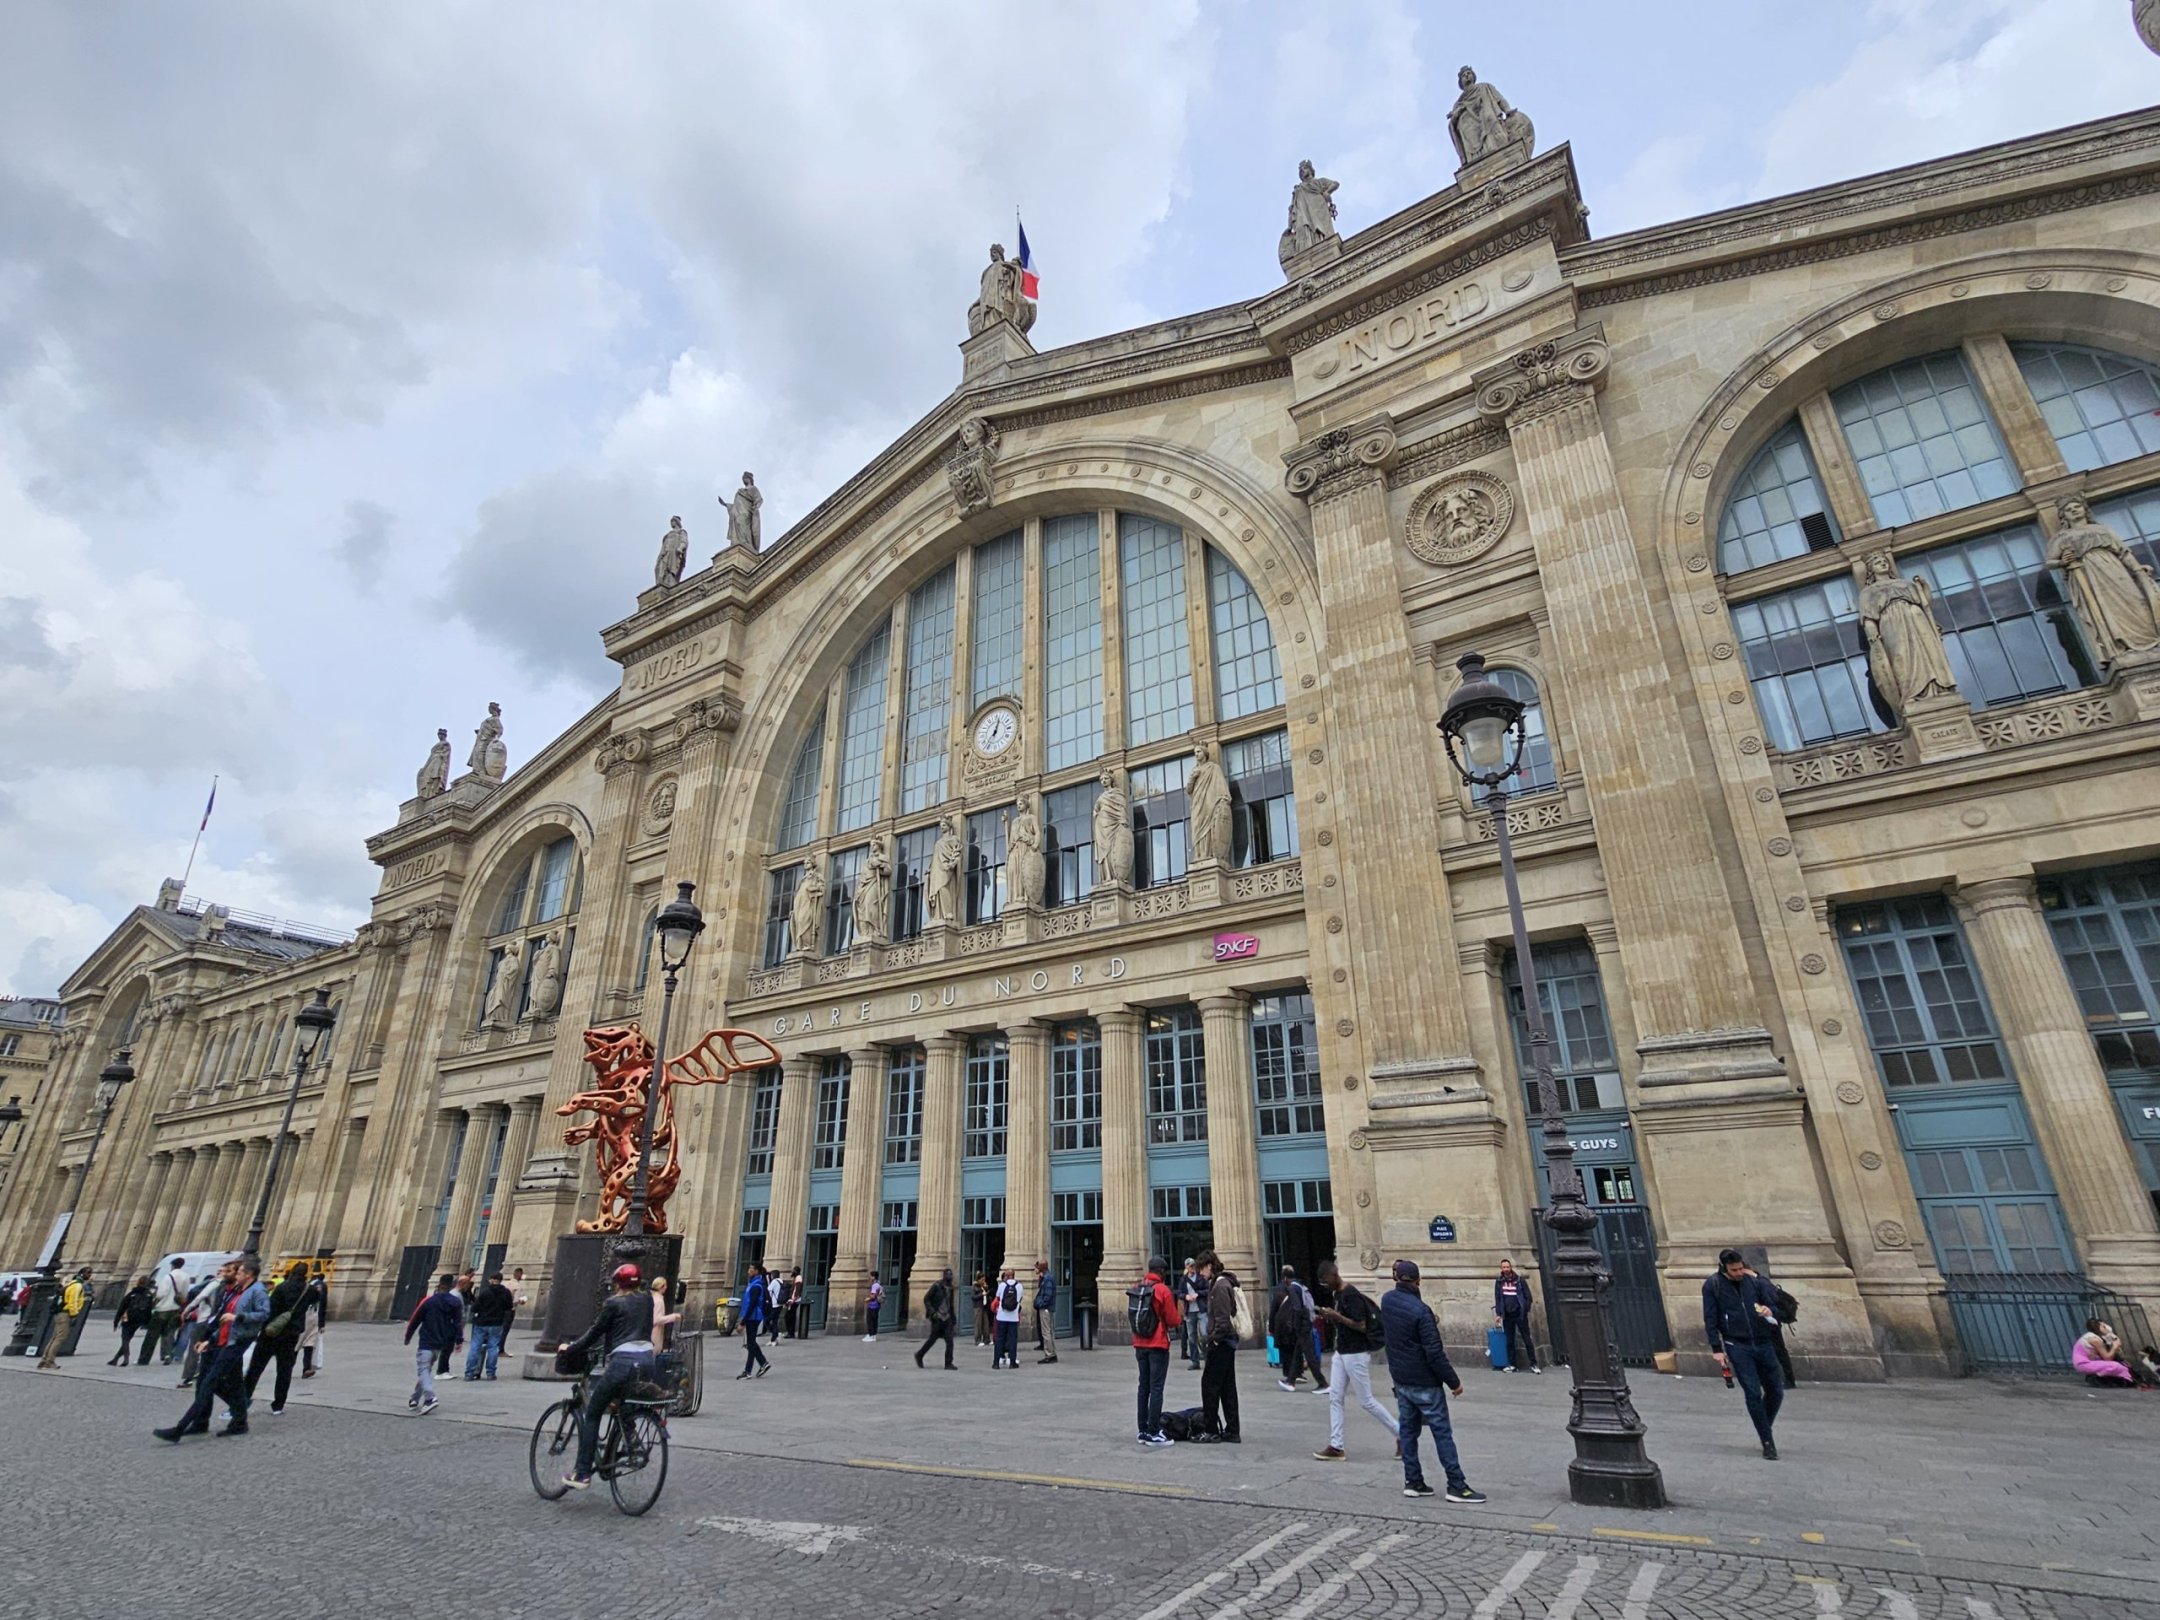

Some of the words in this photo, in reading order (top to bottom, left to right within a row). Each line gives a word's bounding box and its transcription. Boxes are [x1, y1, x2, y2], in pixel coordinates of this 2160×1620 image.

[1345, 281, 1491, 372] NORD
[640, 640, 703, 690] NORD
[1930, 728, 1959, 739] CALAIS
[391, 853, 437, 889] NORD
[1215, 937, 1255, 957] SNCF
[774, 1001, 872, 1035] GARE
[910, 986, 956, 1013] DU
[995, 957, 1126, 999] NORD
[1580, 1138, 1618, 1150] GUYS
